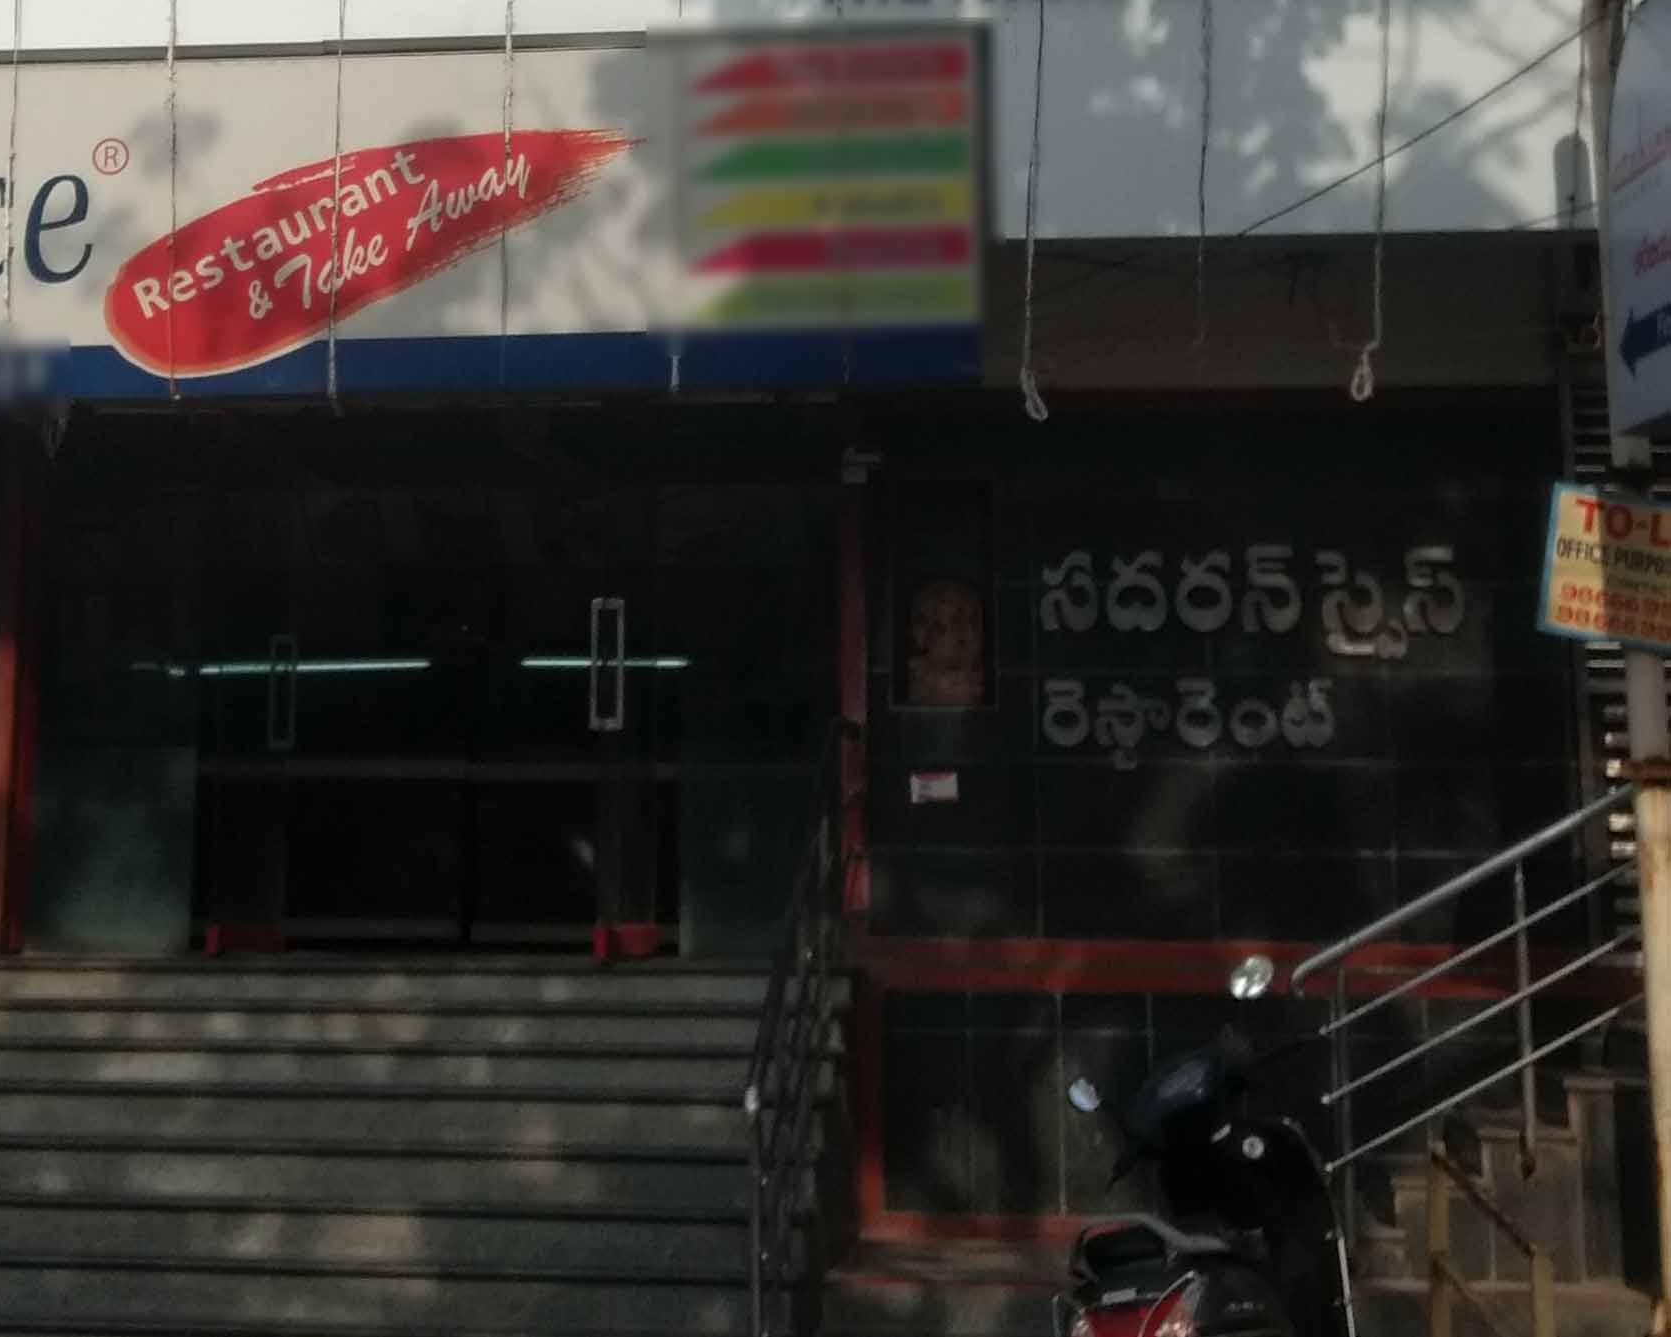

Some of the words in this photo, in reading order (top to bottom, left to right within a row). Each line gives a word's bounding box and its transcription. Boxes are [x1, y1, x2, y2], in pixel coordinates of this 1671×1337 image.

[132, 148, 426, 319] Restaurant
[248, 279, 273, 319] &
[274, 227, 389, 310] Take
[406, 152, 531, 248] Away
